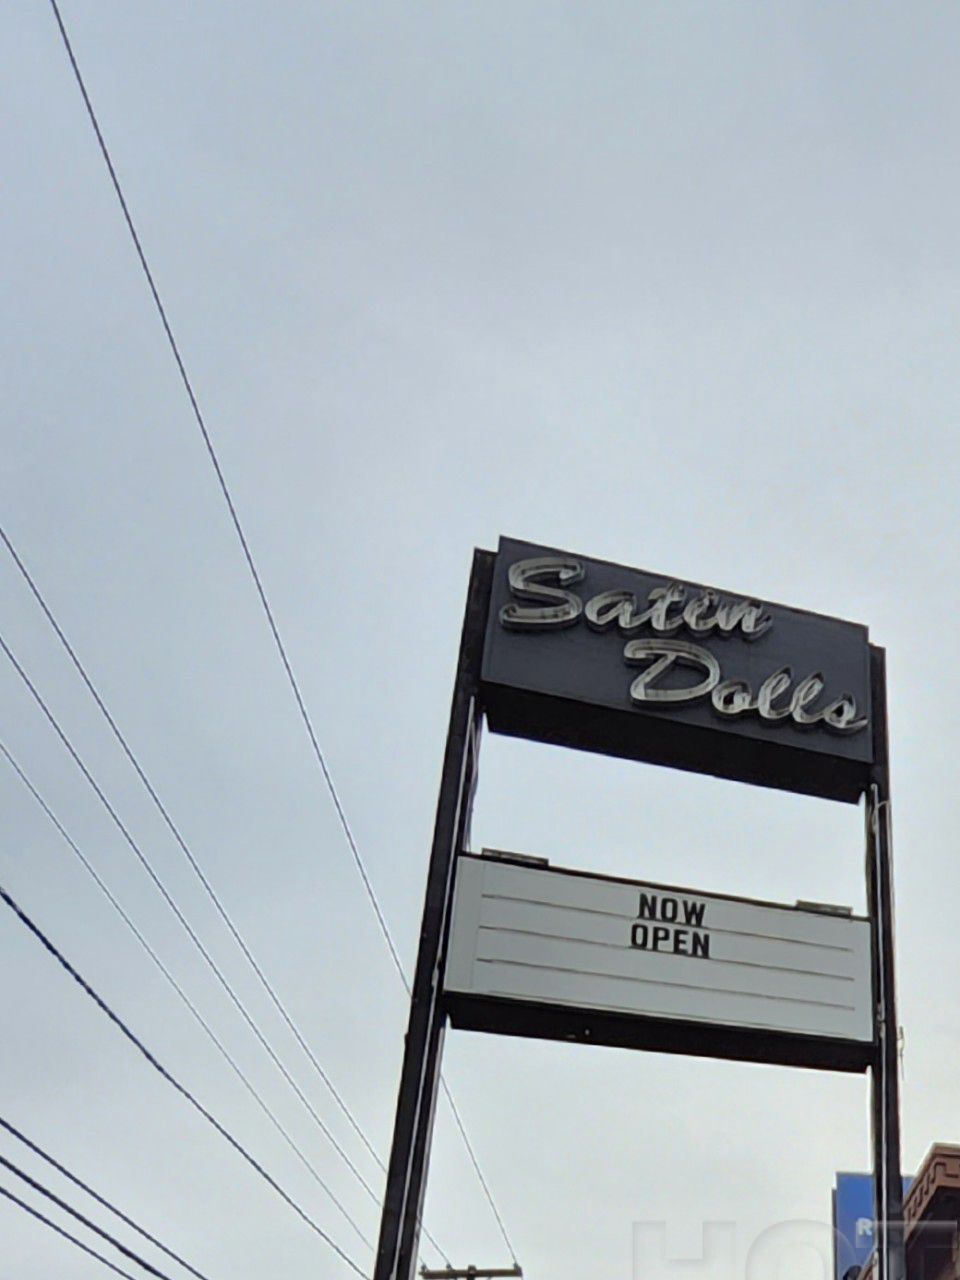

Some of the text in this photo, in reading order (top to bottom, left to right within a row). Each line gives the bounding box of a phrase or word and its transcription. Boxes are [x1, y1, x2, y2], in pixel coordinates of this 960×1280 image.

[500, 556, 773, 640] Satin
[623, 638, 869, 734] Dolls
[637, 893, 706, 928] NOW
[630, 923, 710, 959] OPEN
